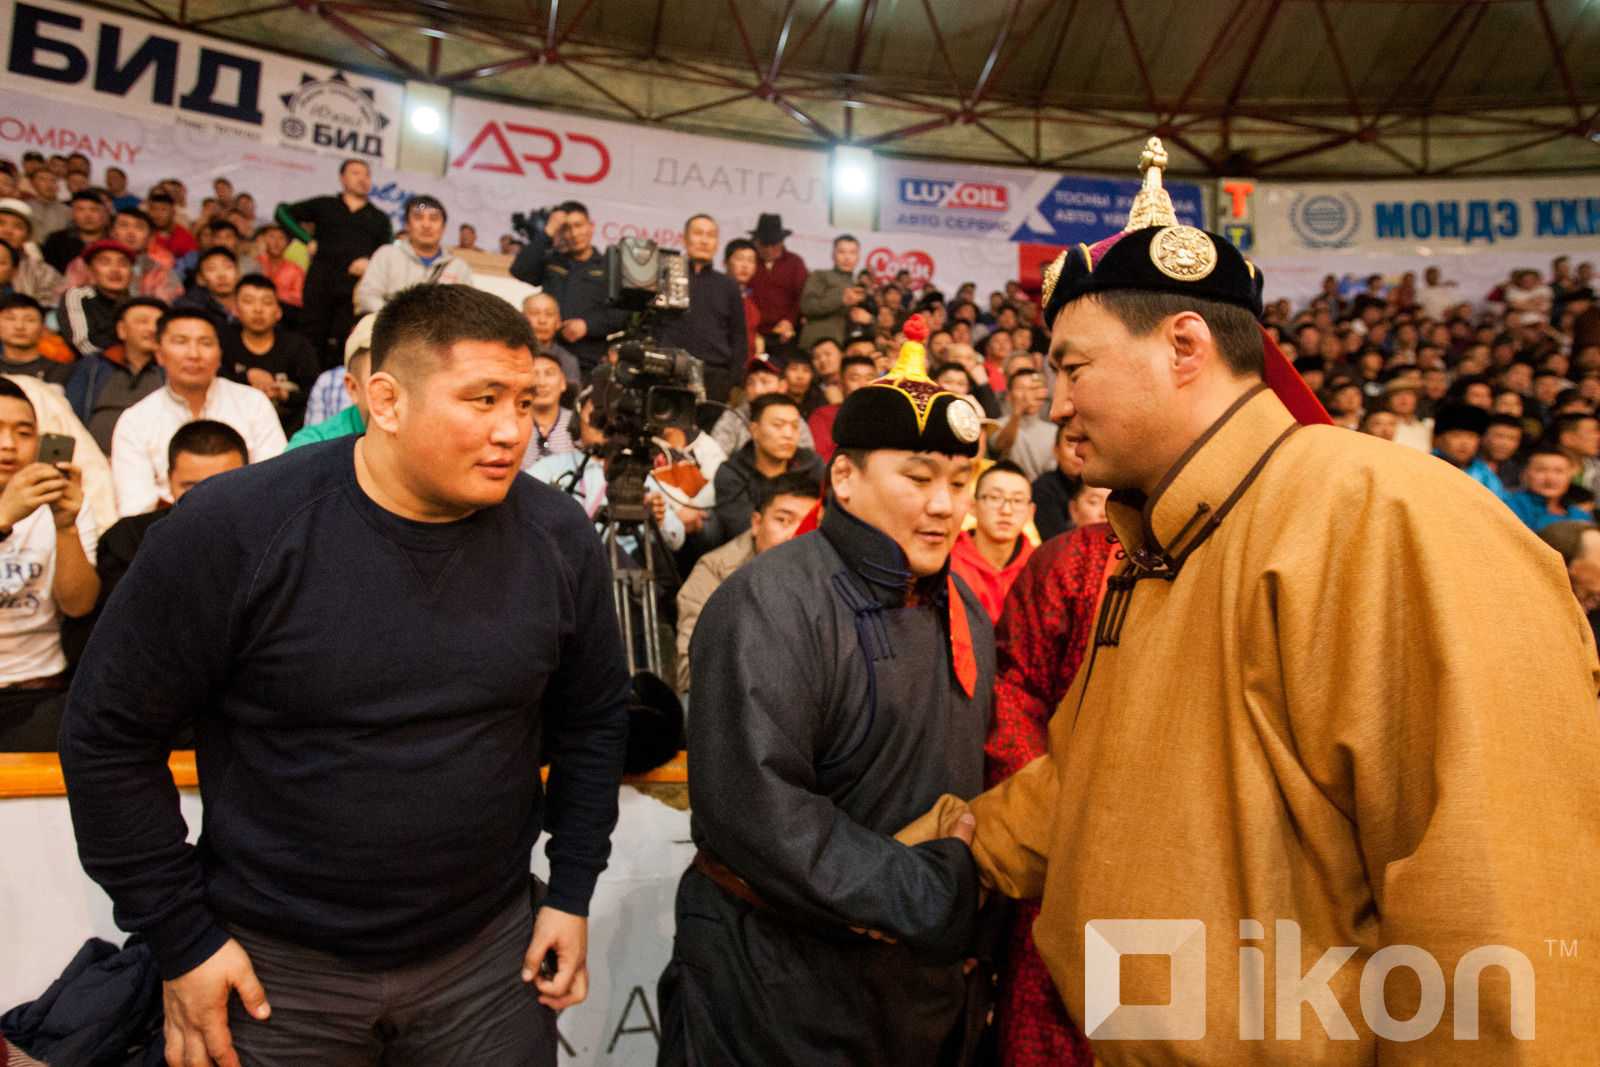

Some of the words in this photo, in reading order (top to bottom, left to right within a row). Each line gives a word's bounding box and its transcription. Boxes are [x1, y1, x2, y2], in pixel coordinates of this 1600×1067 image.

[8, 2, 263, 125] БИД
[0, 117, 141, 165] OMPANY
[313, 122, 383, 158] БИД
[452, 120, 611, 185] ARD
[653, 156, 827, 204] ДААТГАЛ
[905, 181, 1005, 209] LUXOIL
[601, 221, 686, 247] COMPA
[1375, 200, 1519, 243] МОНДЭ
[0, 562, 43, 579] RD
